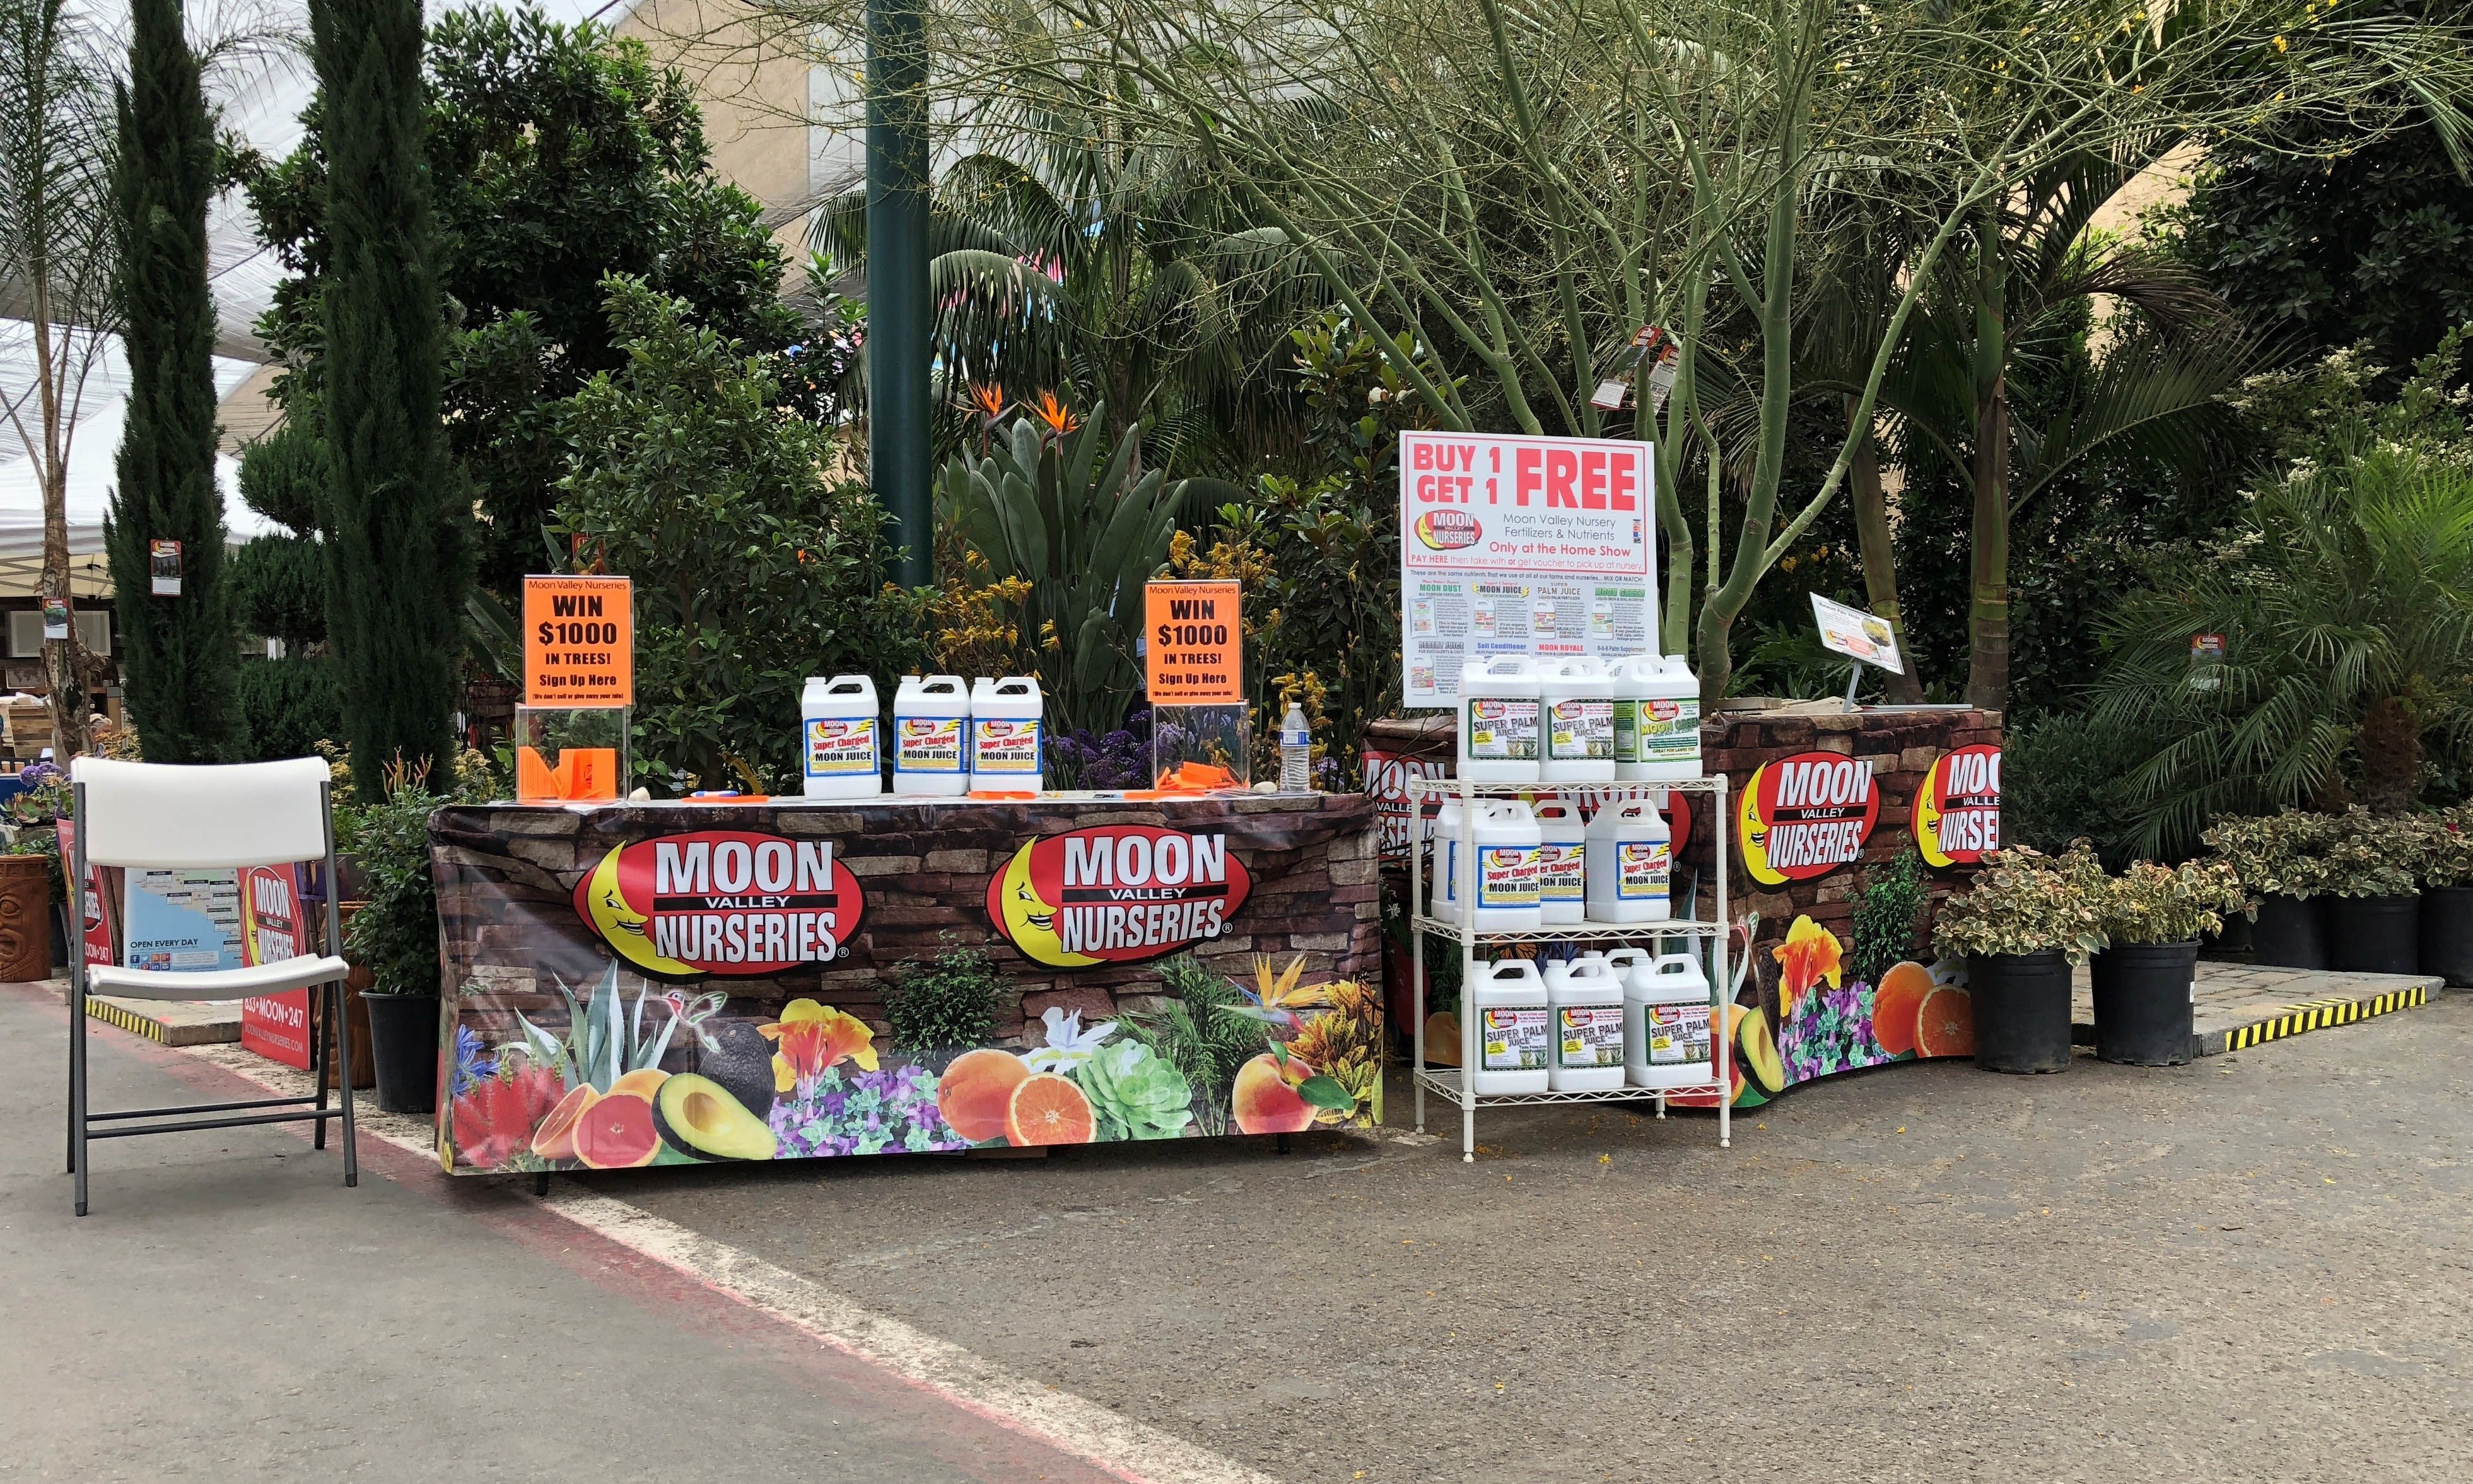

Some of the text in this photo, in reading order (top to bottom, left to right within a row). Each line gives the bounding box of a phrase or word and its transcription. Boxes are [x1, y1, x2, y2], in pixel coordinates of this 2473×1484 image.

[1414, 443, 1635, 511] BUY 1 FREE
[1417, 475, 1497, 504] GET 1
[1433, 512, 1474, 527] MOON
[1504, 513, 1616, 529] Moon Valley Nursery
[1433, 530, 1475, 545] NURSERIES
[1505, 527, 1615, 540] Fertilizers & Nutrients
[1490, 542, 1631, 557] Only at the Home Show
[1412, 554, 1427, 563] PAY
[1430, 555, 1448, 563] HERE
[1451, 556, 1468, 564] then
[1471, 556, 1488, 564] take
[1490, 557, 1506, 565] with
[1518, 559, 1531, 567] get
[1534, 559, 1565, 567] voucher
[1577, 560, 1593, 570] pick
[529, 580, 626, 591] Moon Valley Nurseries
[1150, 586, 1236, 595] Moon Valley Nurseries
[1420, 584, 1441, 592] MOON
[1480, 585, 1522, 593] MOON JUICE
[1538, 587, 1581, 595] PALM JUICE
[1594, 587, 1618, 597] MOON
[552, 595, 602, 617] WIN
[1170, 600, 1214, 619] WIN
[539, 621, 617, 646] $1000
[1159, 624, 1227, 647] $1000
[1418, 641, 1444, 649] DESERT
[546, 653, 611, 665] IN TREES!
[1164, 653, 1222, 664] IN TREES!
[539, 674, 617, 687] Sign Up Here
[1159, 673, 1227, 685] Sign Up Here
[1474, 716, 1538, 732] SUPER PALM
[1640, 717, 1700, 735] MOON GREEN
[1495, 728, 1519, 737] JUICE
[814, 735, 869, 751] Super Charged
[903, 735, 955, 747] Super Charged
[979, 736, 1033, 749] Super Charged
[816, 751, 872, 761] MOON JUICE
[904, 751, 957, 759] MOON JUICE
[1010, 752, 1035, 760] JUICE
[1776, 760, 1873, 807] MOON
[1376, 802, 1424, 812] VALLE
[1801, 807, 1845, 820] VALLEY
[655, 840, 834, 894] MOON
[1063, 834, 1225, 887] MOON
[1487, 870, 1510, 880] Super
[1512, 865, 1538, 878] Charged
[1109, 887, 1187, 901] VALLEY
[1488, 883, 1539, 892] MOON JUICE
[254, 875, 291, 919] MOON
[704, 896, 790, 909] VALLEY
[266, 917, 283, 929] VALLEY
[1487, 1025, 1548, 1042] SUPER PALM
[1564, 1022, 1623, 1041] SUPER PALM
[1651, 1019, 1710, 1038] SUPER PALM
[1508, 1037, 1529, 1047] JUICE
[1584, 1036, 1606, 1045] JUICE
[1673, 1032, 1693, 1042] JUICE
